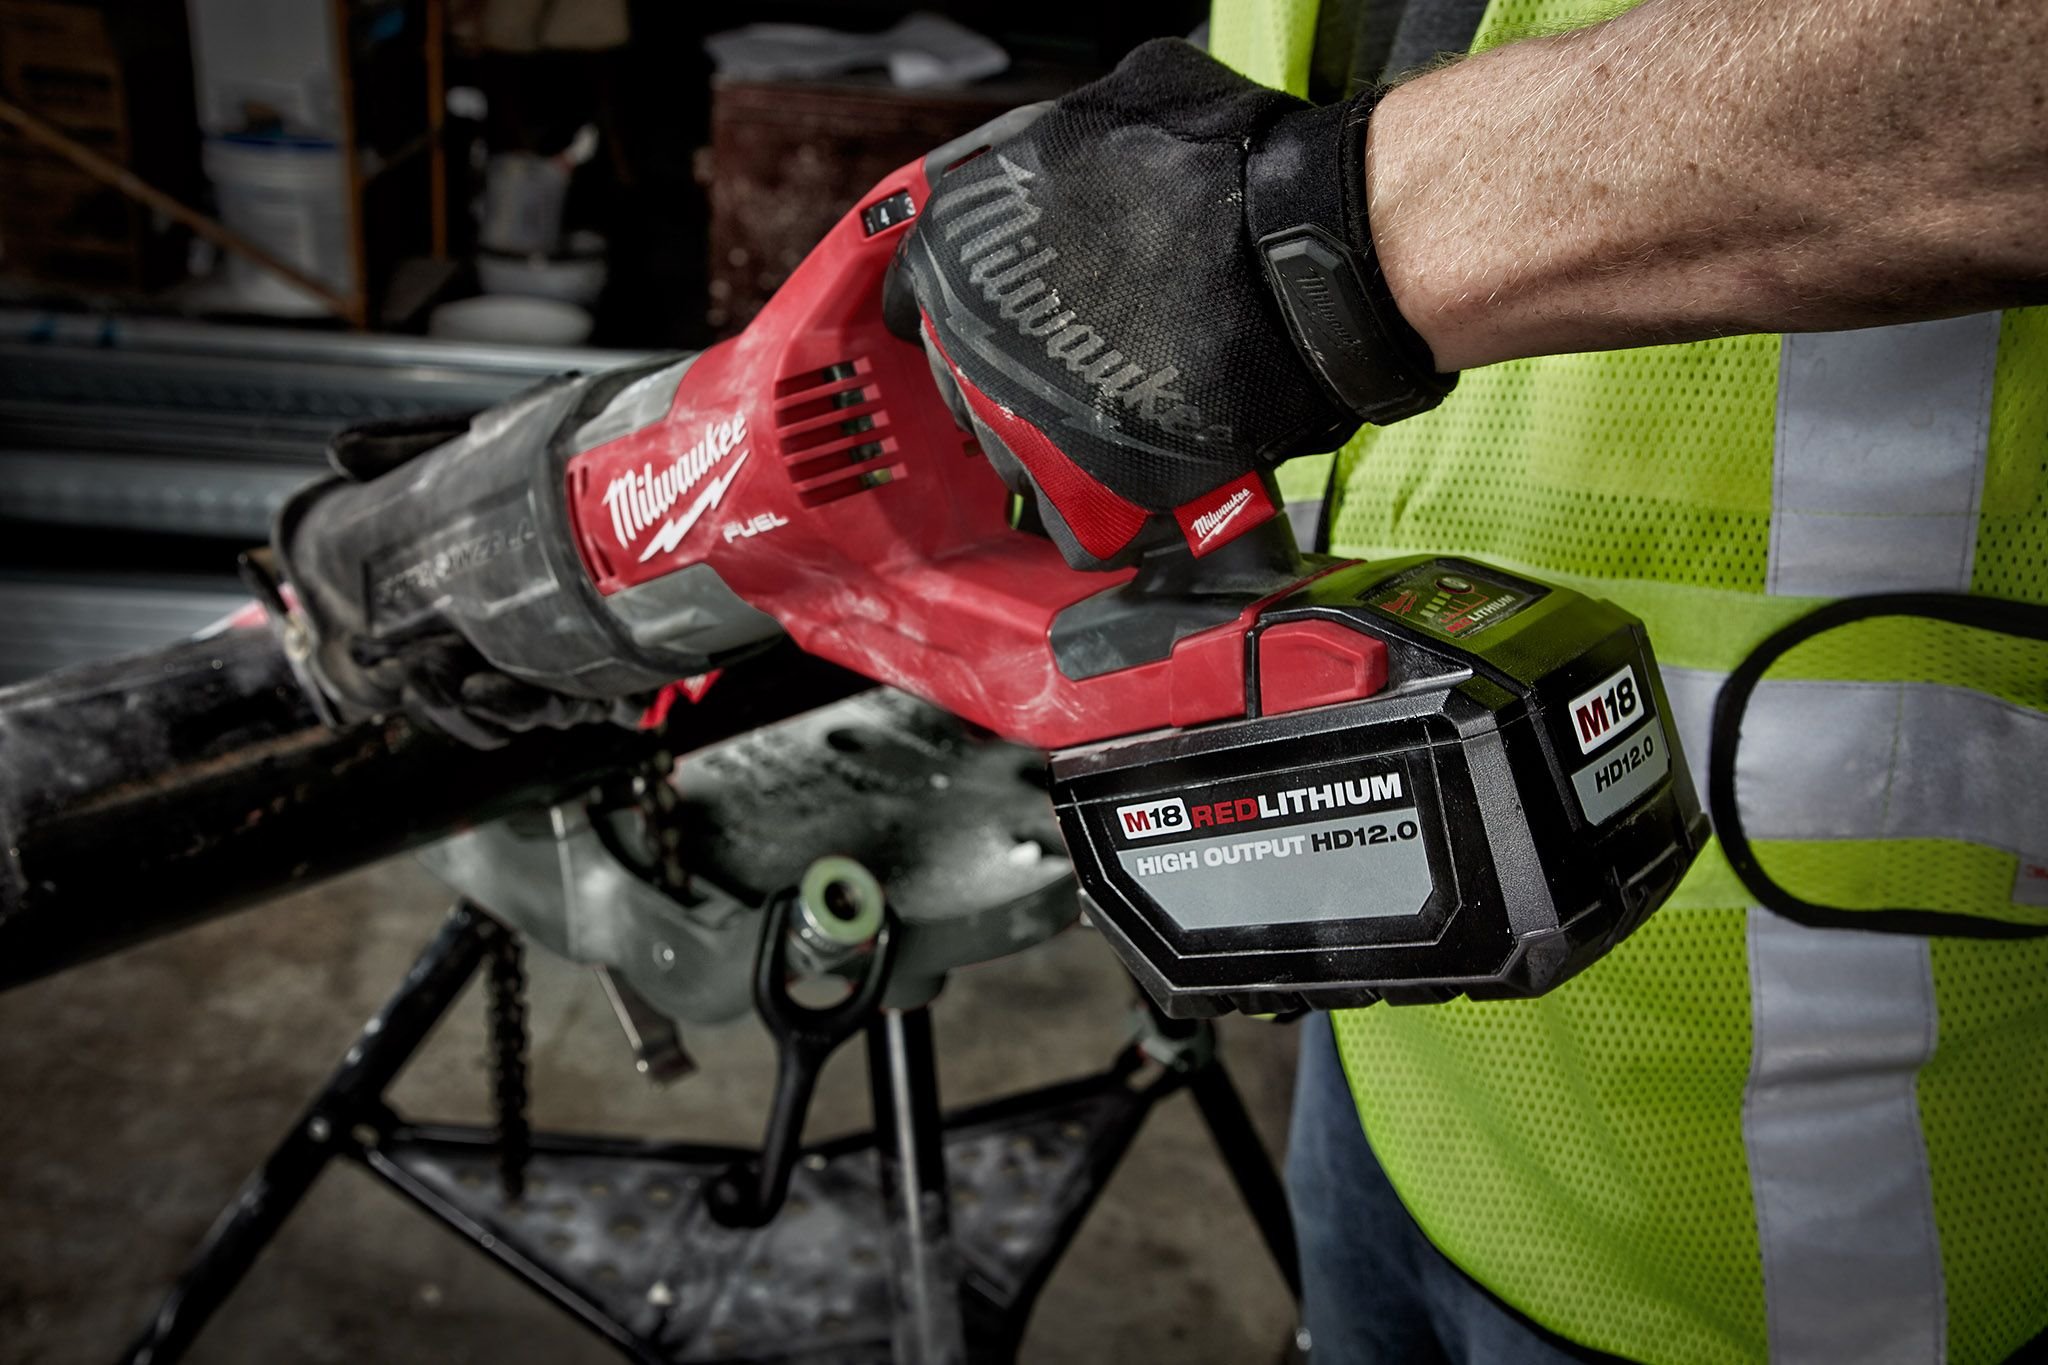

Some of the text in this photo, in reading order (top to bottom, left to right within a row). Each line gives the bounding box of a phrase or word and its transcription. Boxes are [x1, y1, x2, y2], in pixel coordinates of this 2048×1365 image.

[602, 411, 748, 549] Milwaukee
[723, 512, 789, 544] FUEL
[1191, 488, 1250, 538] Milwaukee
[1576, 677, 1637, 744] M18
[1595, 735, 1654, 793] HD12.0
[1123, 772, 1403, 833] M18 REDLITHIUM
[1136, 820, 1418, 876] HIGH OUTPUT HD12.0
